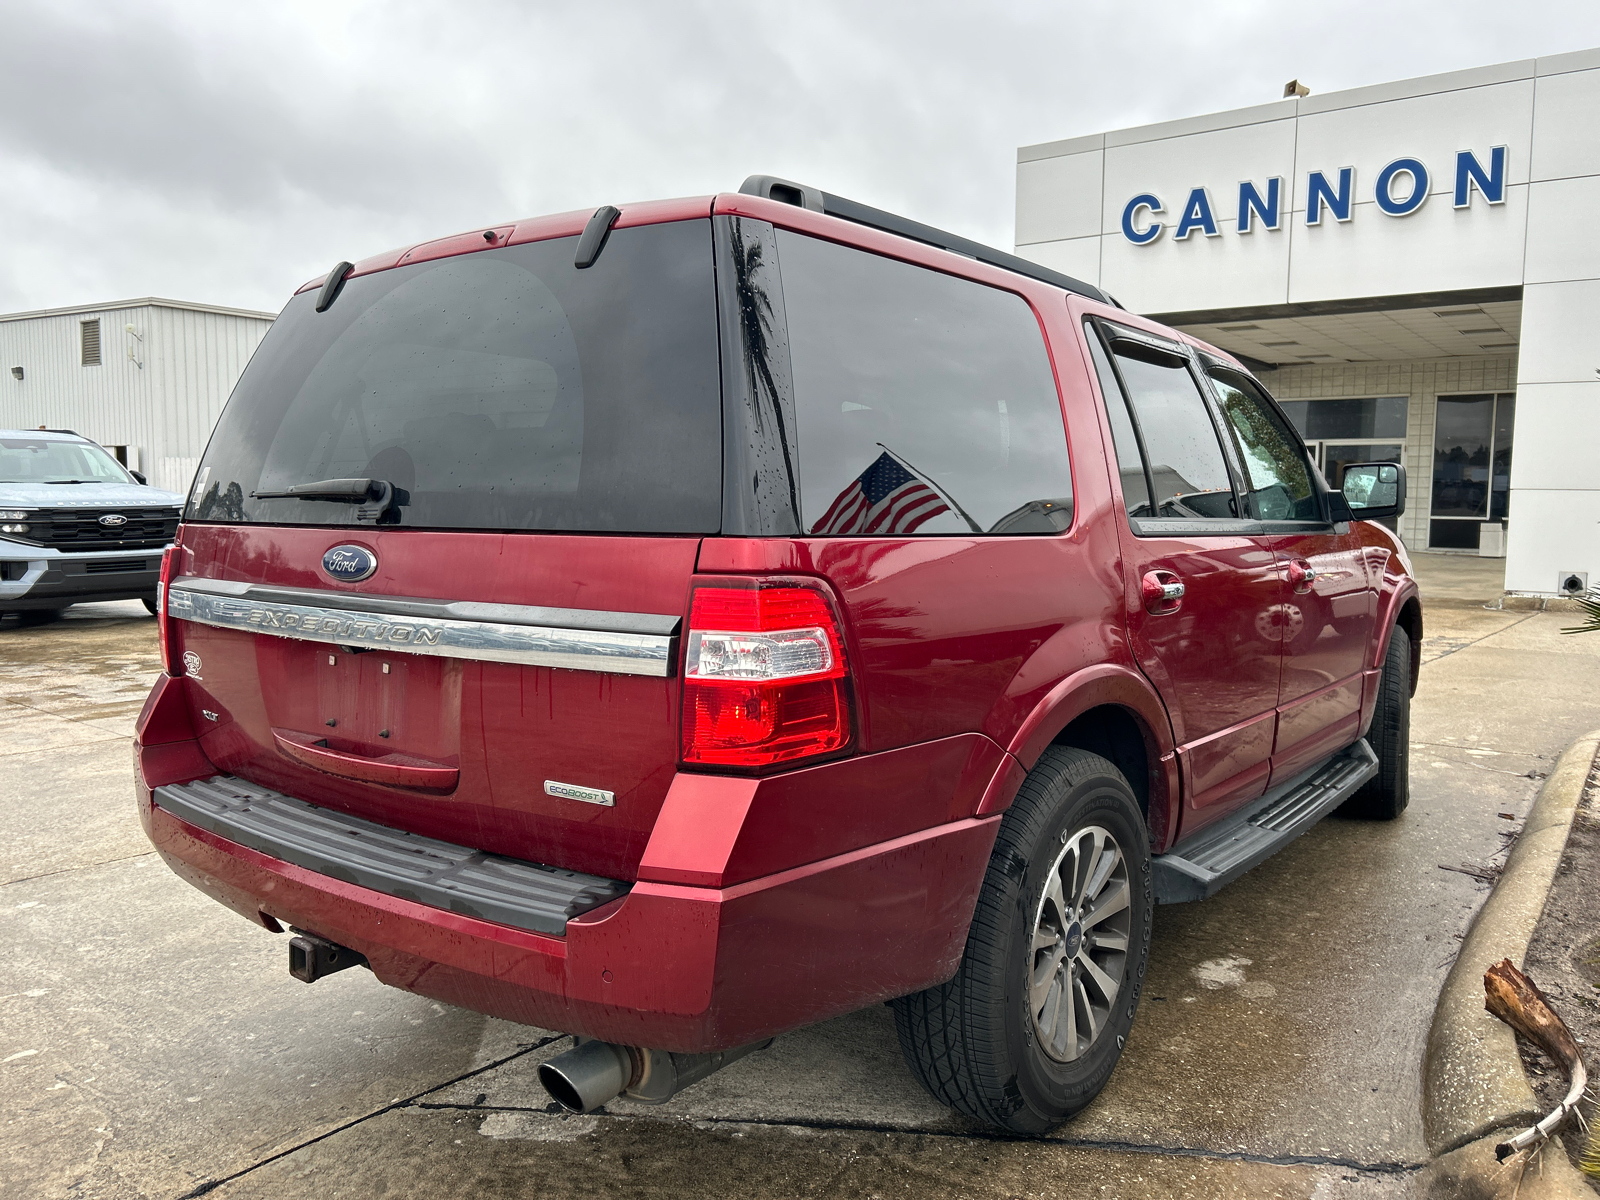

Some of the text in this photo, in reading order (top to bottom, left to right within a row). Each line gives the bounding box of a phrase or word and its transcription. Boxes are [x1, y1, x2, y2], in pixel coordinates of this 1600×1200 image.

[1120, 144, 1508, 246] CANNON
[328, 550, 358, 573] Ford
[247, 608, 443, 646] EXPEDITION
[549, 785, 600, 800] ECOBOOST
